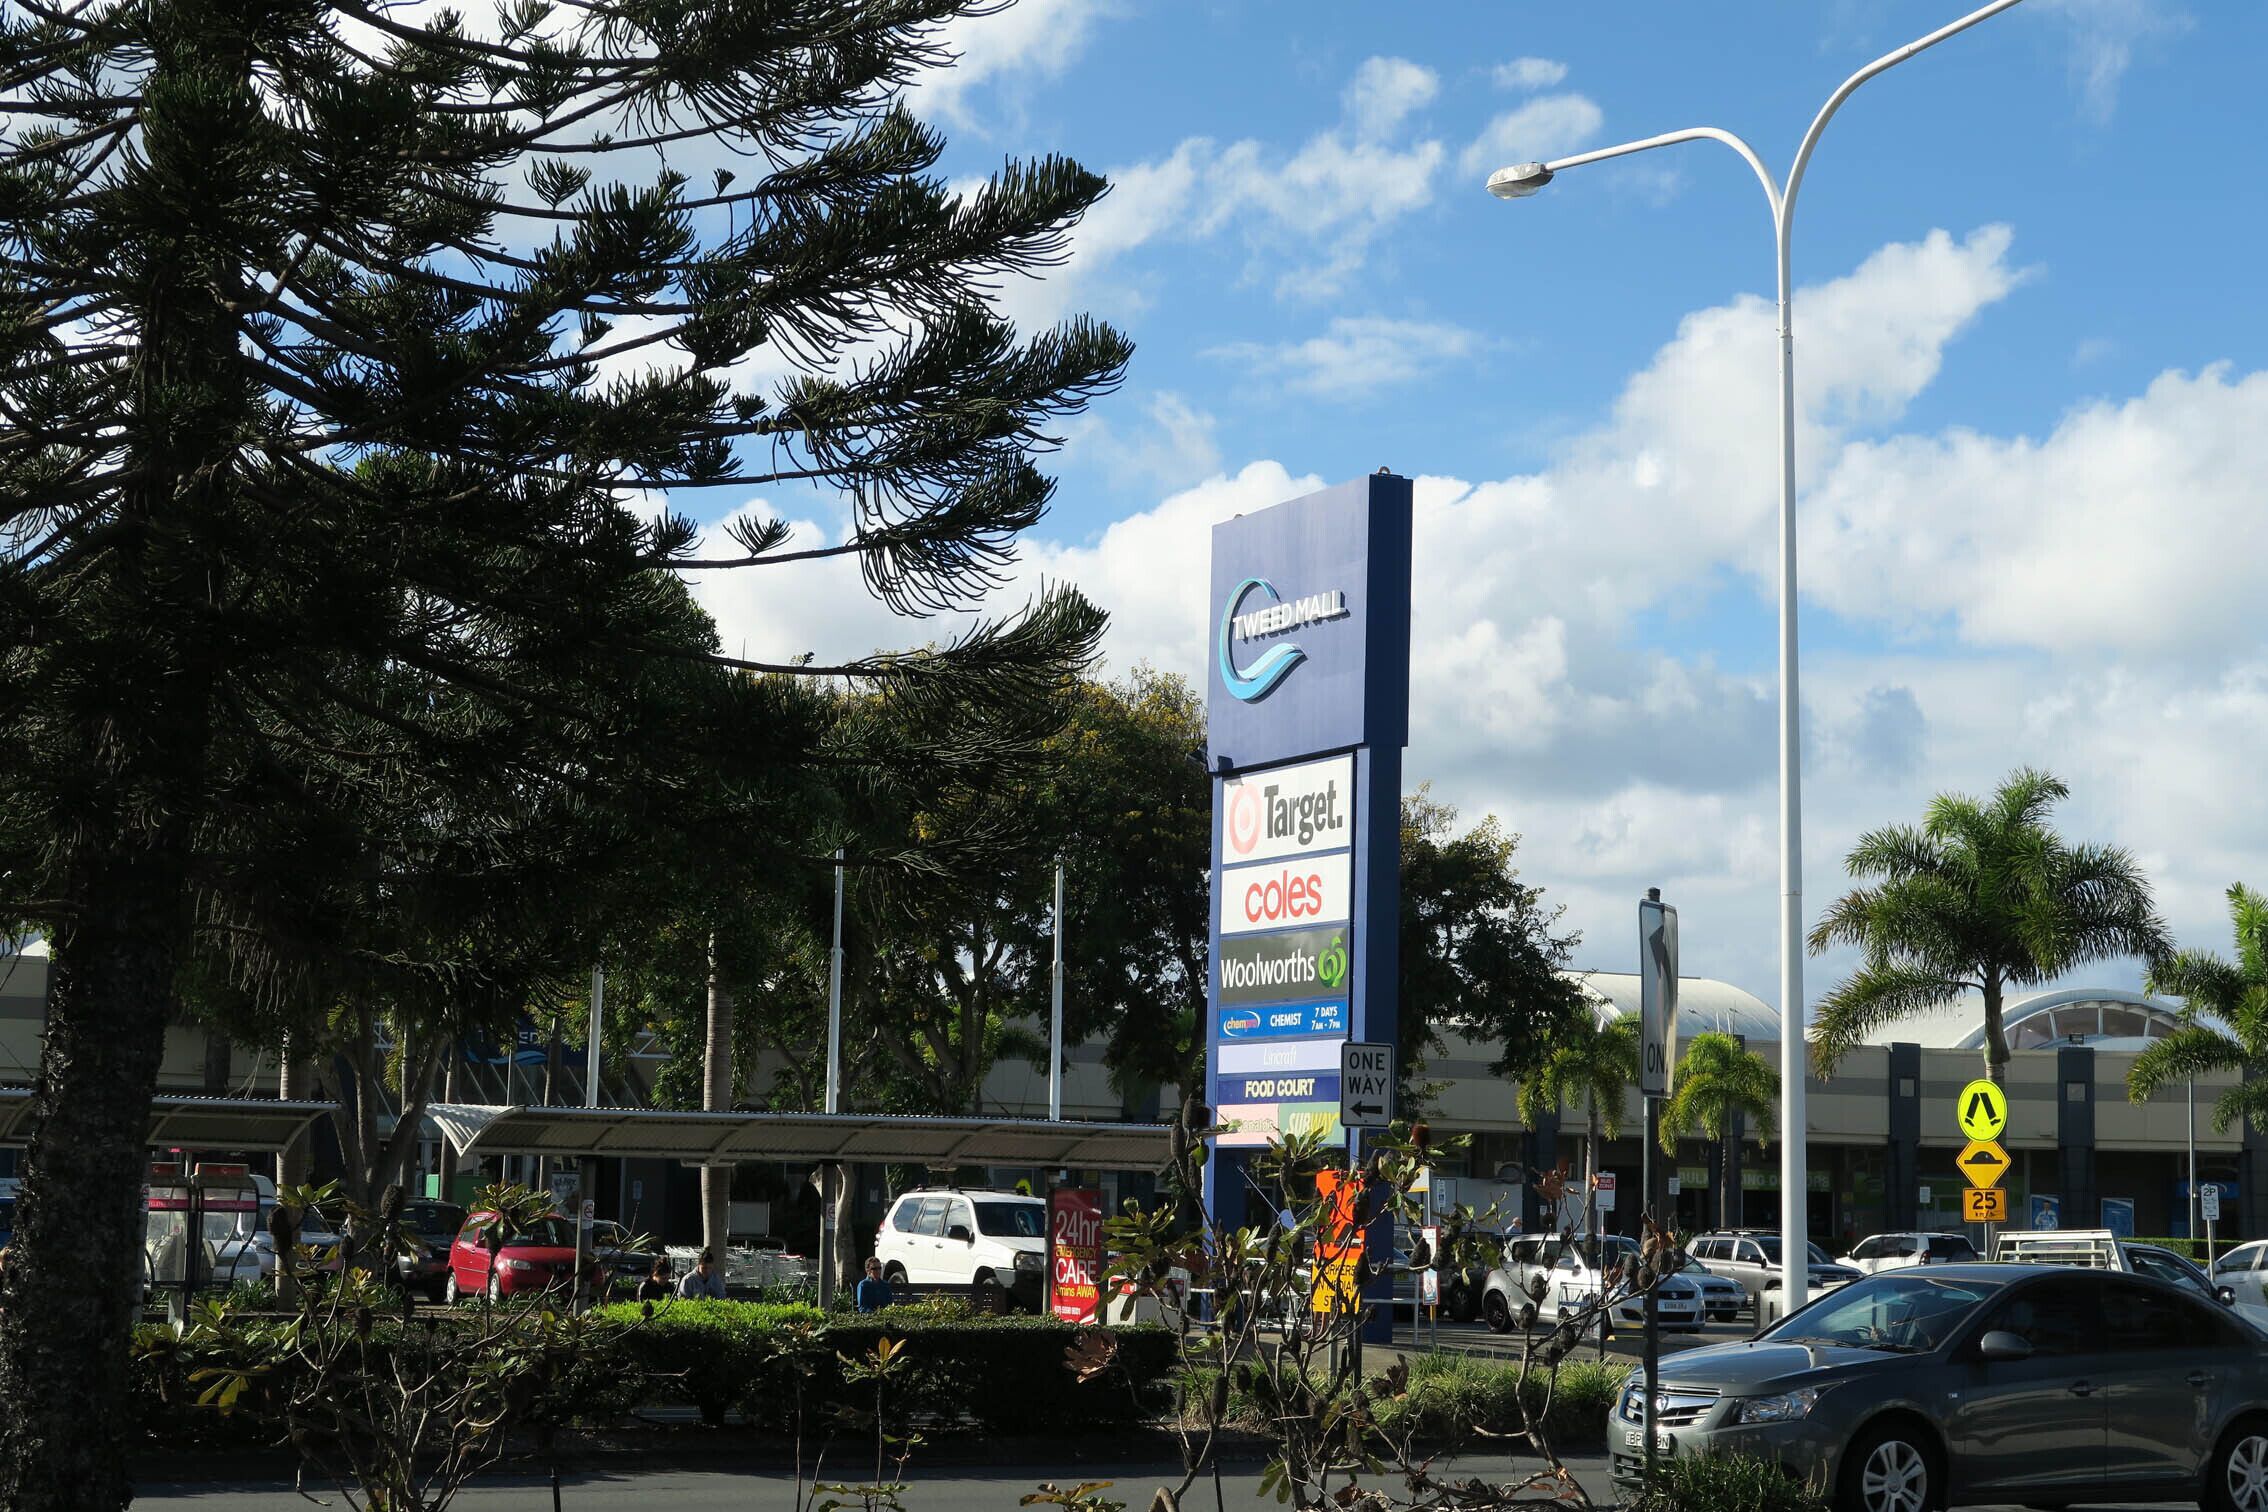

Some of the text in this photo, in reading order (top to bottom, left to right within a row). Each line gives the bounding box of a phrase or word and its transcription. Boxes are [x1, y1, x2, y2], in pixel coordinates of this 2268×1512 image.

[1233, 589, 1346, 640] TWEED MALL
[1245, 870, 1322, 923] coles
[1221, 948, 1316, 988] Woolworths
[1270, 1013, 1302, 1027] CHEMIST
[1321, 1006, 1338, 1017] DAYS
[1350, 1052, 1385, 1071] ONE
[1245, 1078, 1316, 1098] FOOD COURT
[1349, 1076, 1387, 1096] WAY
[1972, 1191, 1997, 1210] 25
[2203, 1187, 2216, 1196] 2P
[1056, 1210, 1100, 1246] 24hr
[1056, 1258, 1097, 1285] CARE
[1076, 1285, 1096, 1298] AWAY
